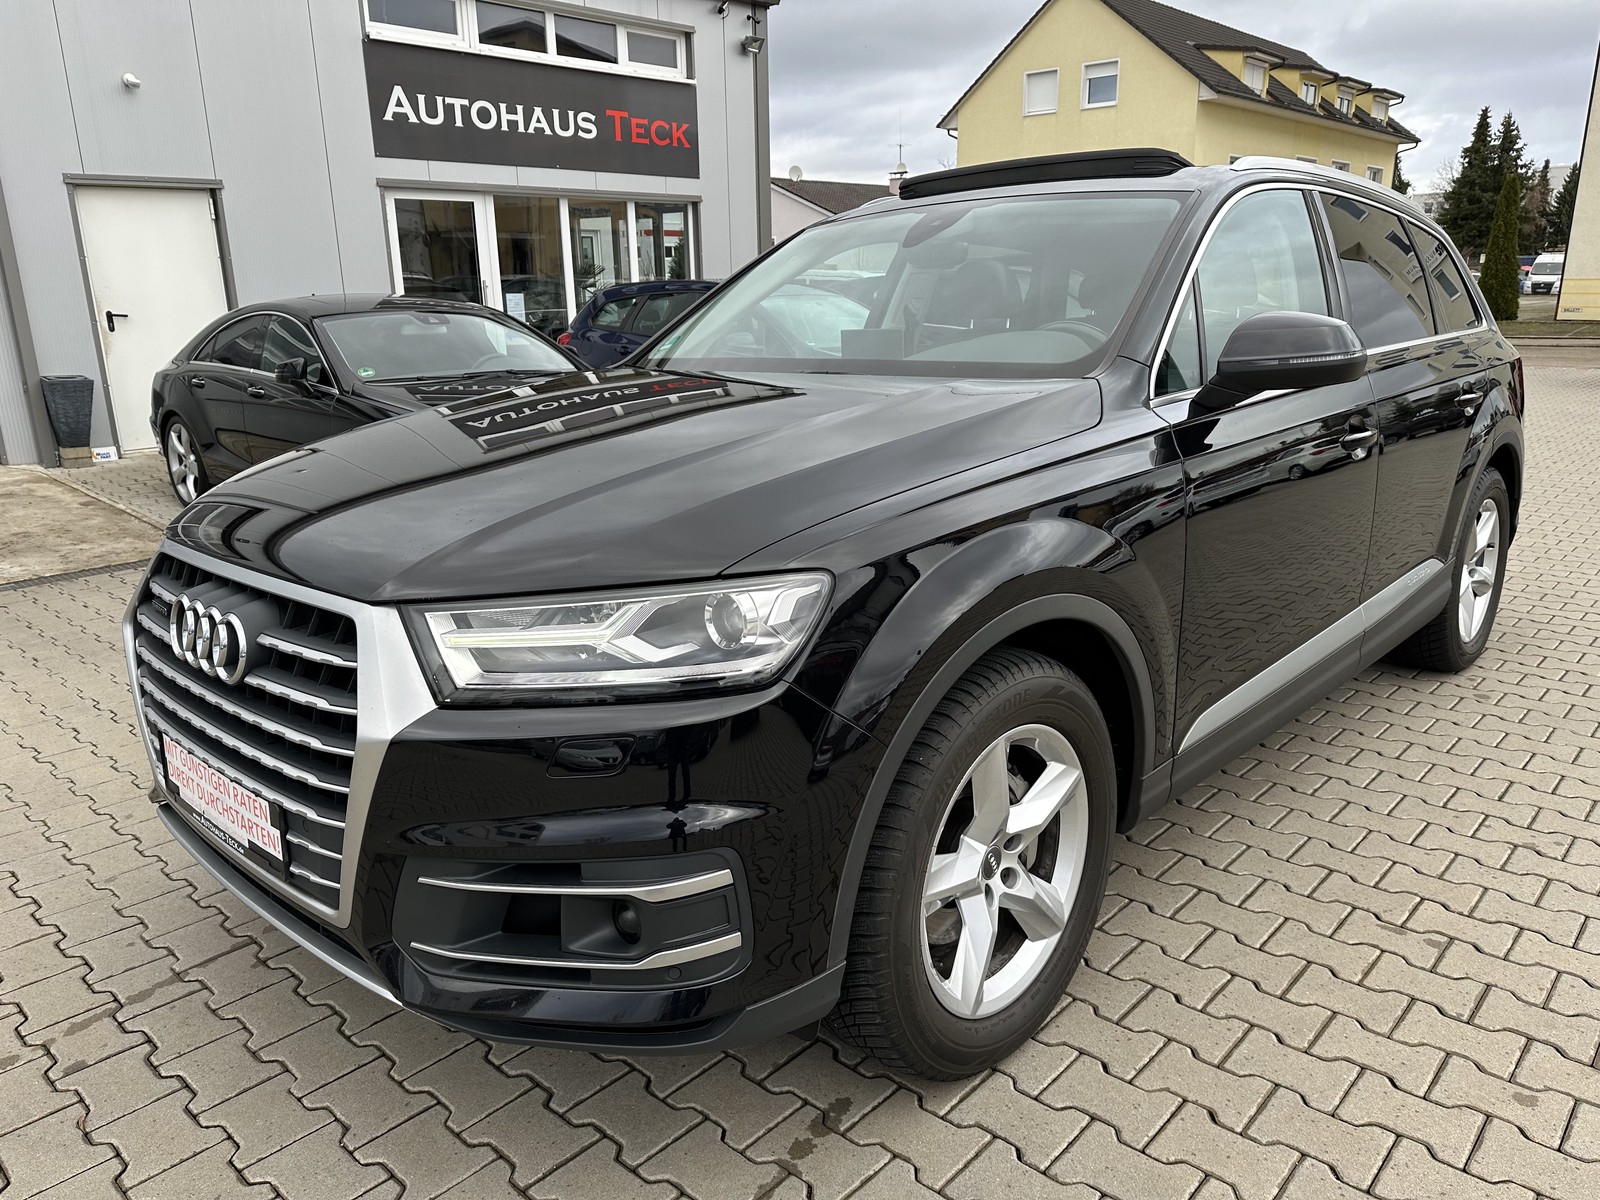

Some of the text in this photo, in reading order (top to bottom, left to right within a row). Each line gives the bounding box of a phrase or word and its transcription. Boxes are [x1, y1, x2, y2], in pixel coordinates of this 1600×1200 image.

[382, 85, 691, 148] AUTOHAUS TECK
[164, 737, 178, 761] MIT
[232, 785, 268, 824] RATEN
[167, 760, 281, 854] DIREKT DURCHSTARTEN!
